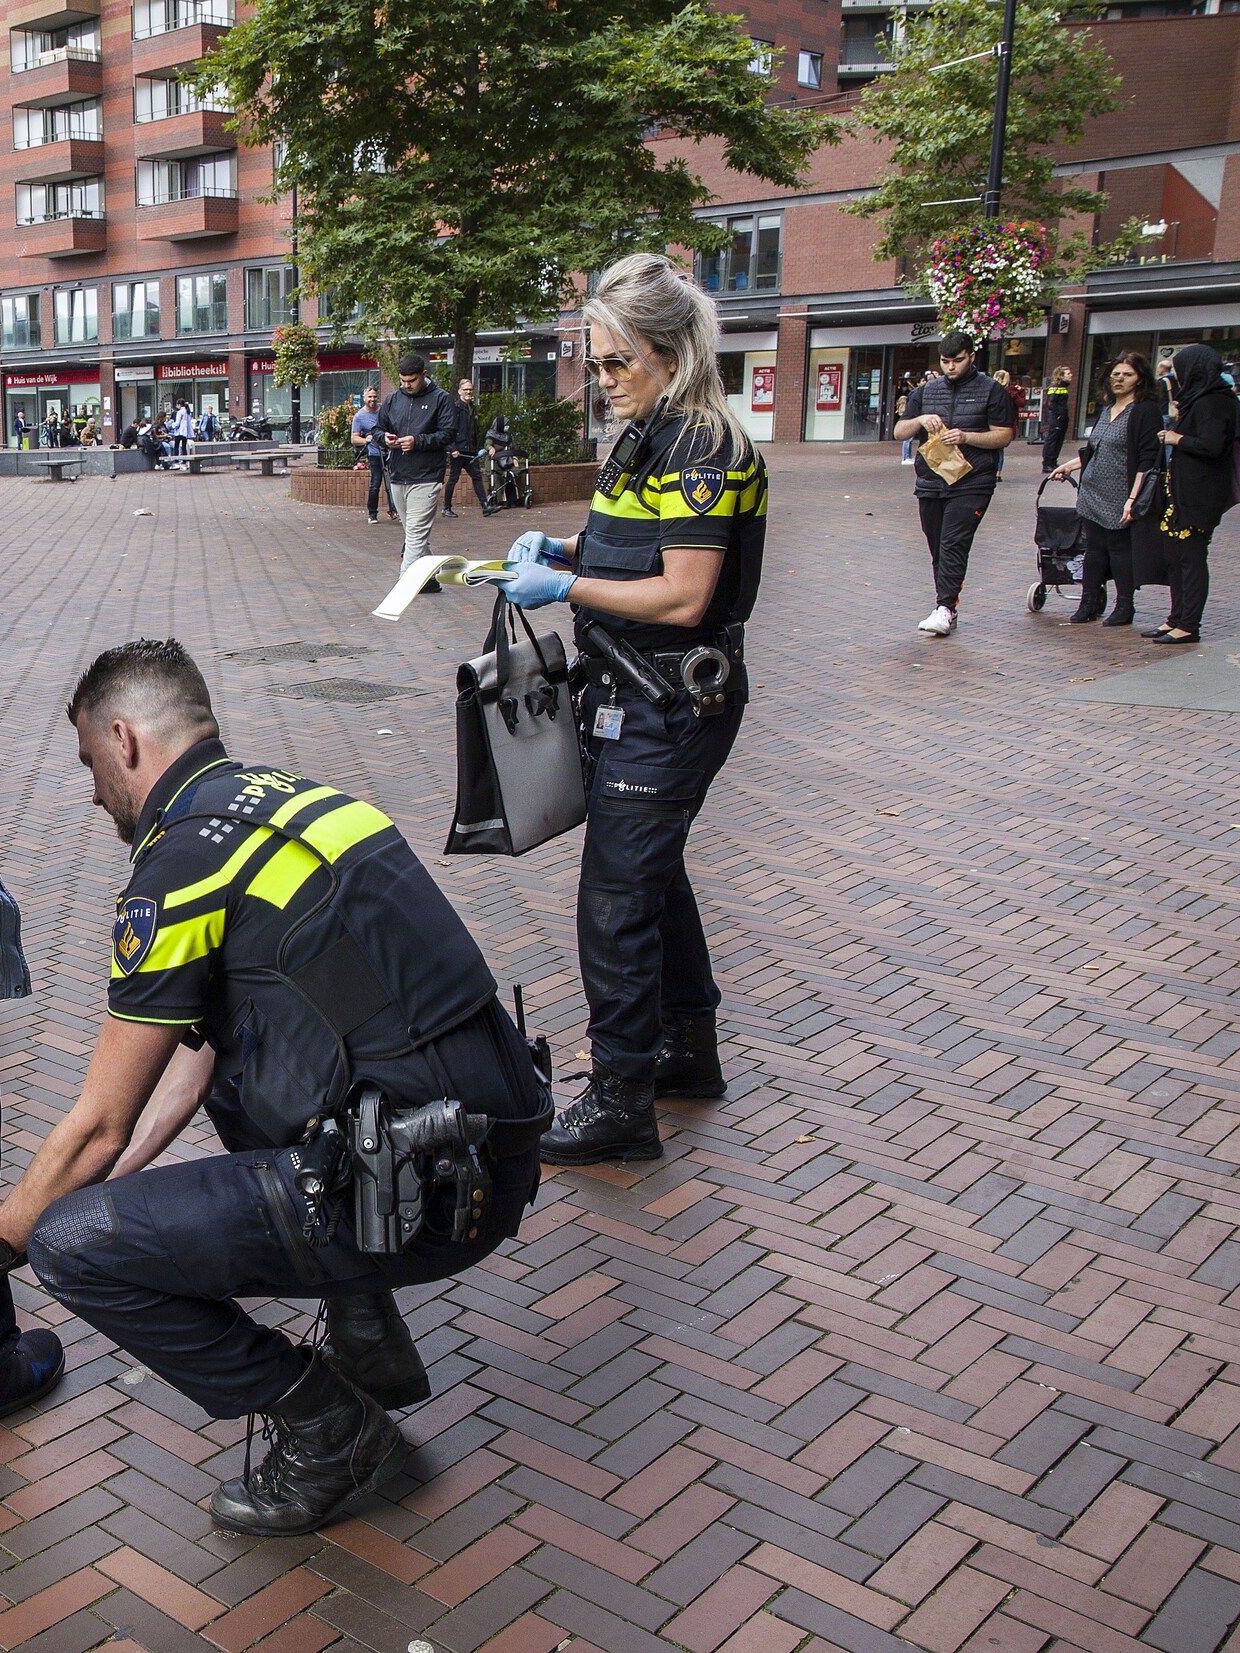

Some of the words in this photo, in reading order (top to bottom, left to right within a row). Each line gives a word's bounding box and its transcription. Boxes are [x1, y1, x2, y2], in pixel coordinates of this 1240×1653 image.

[168, 364, 216, 377] bibliotheek
[36, 375, 44, 383] de
[44, 374, 58, 384] Wijk
[685, 471, 721, 480] POLITIE
[614, 781, 648, 793] POLITIE
